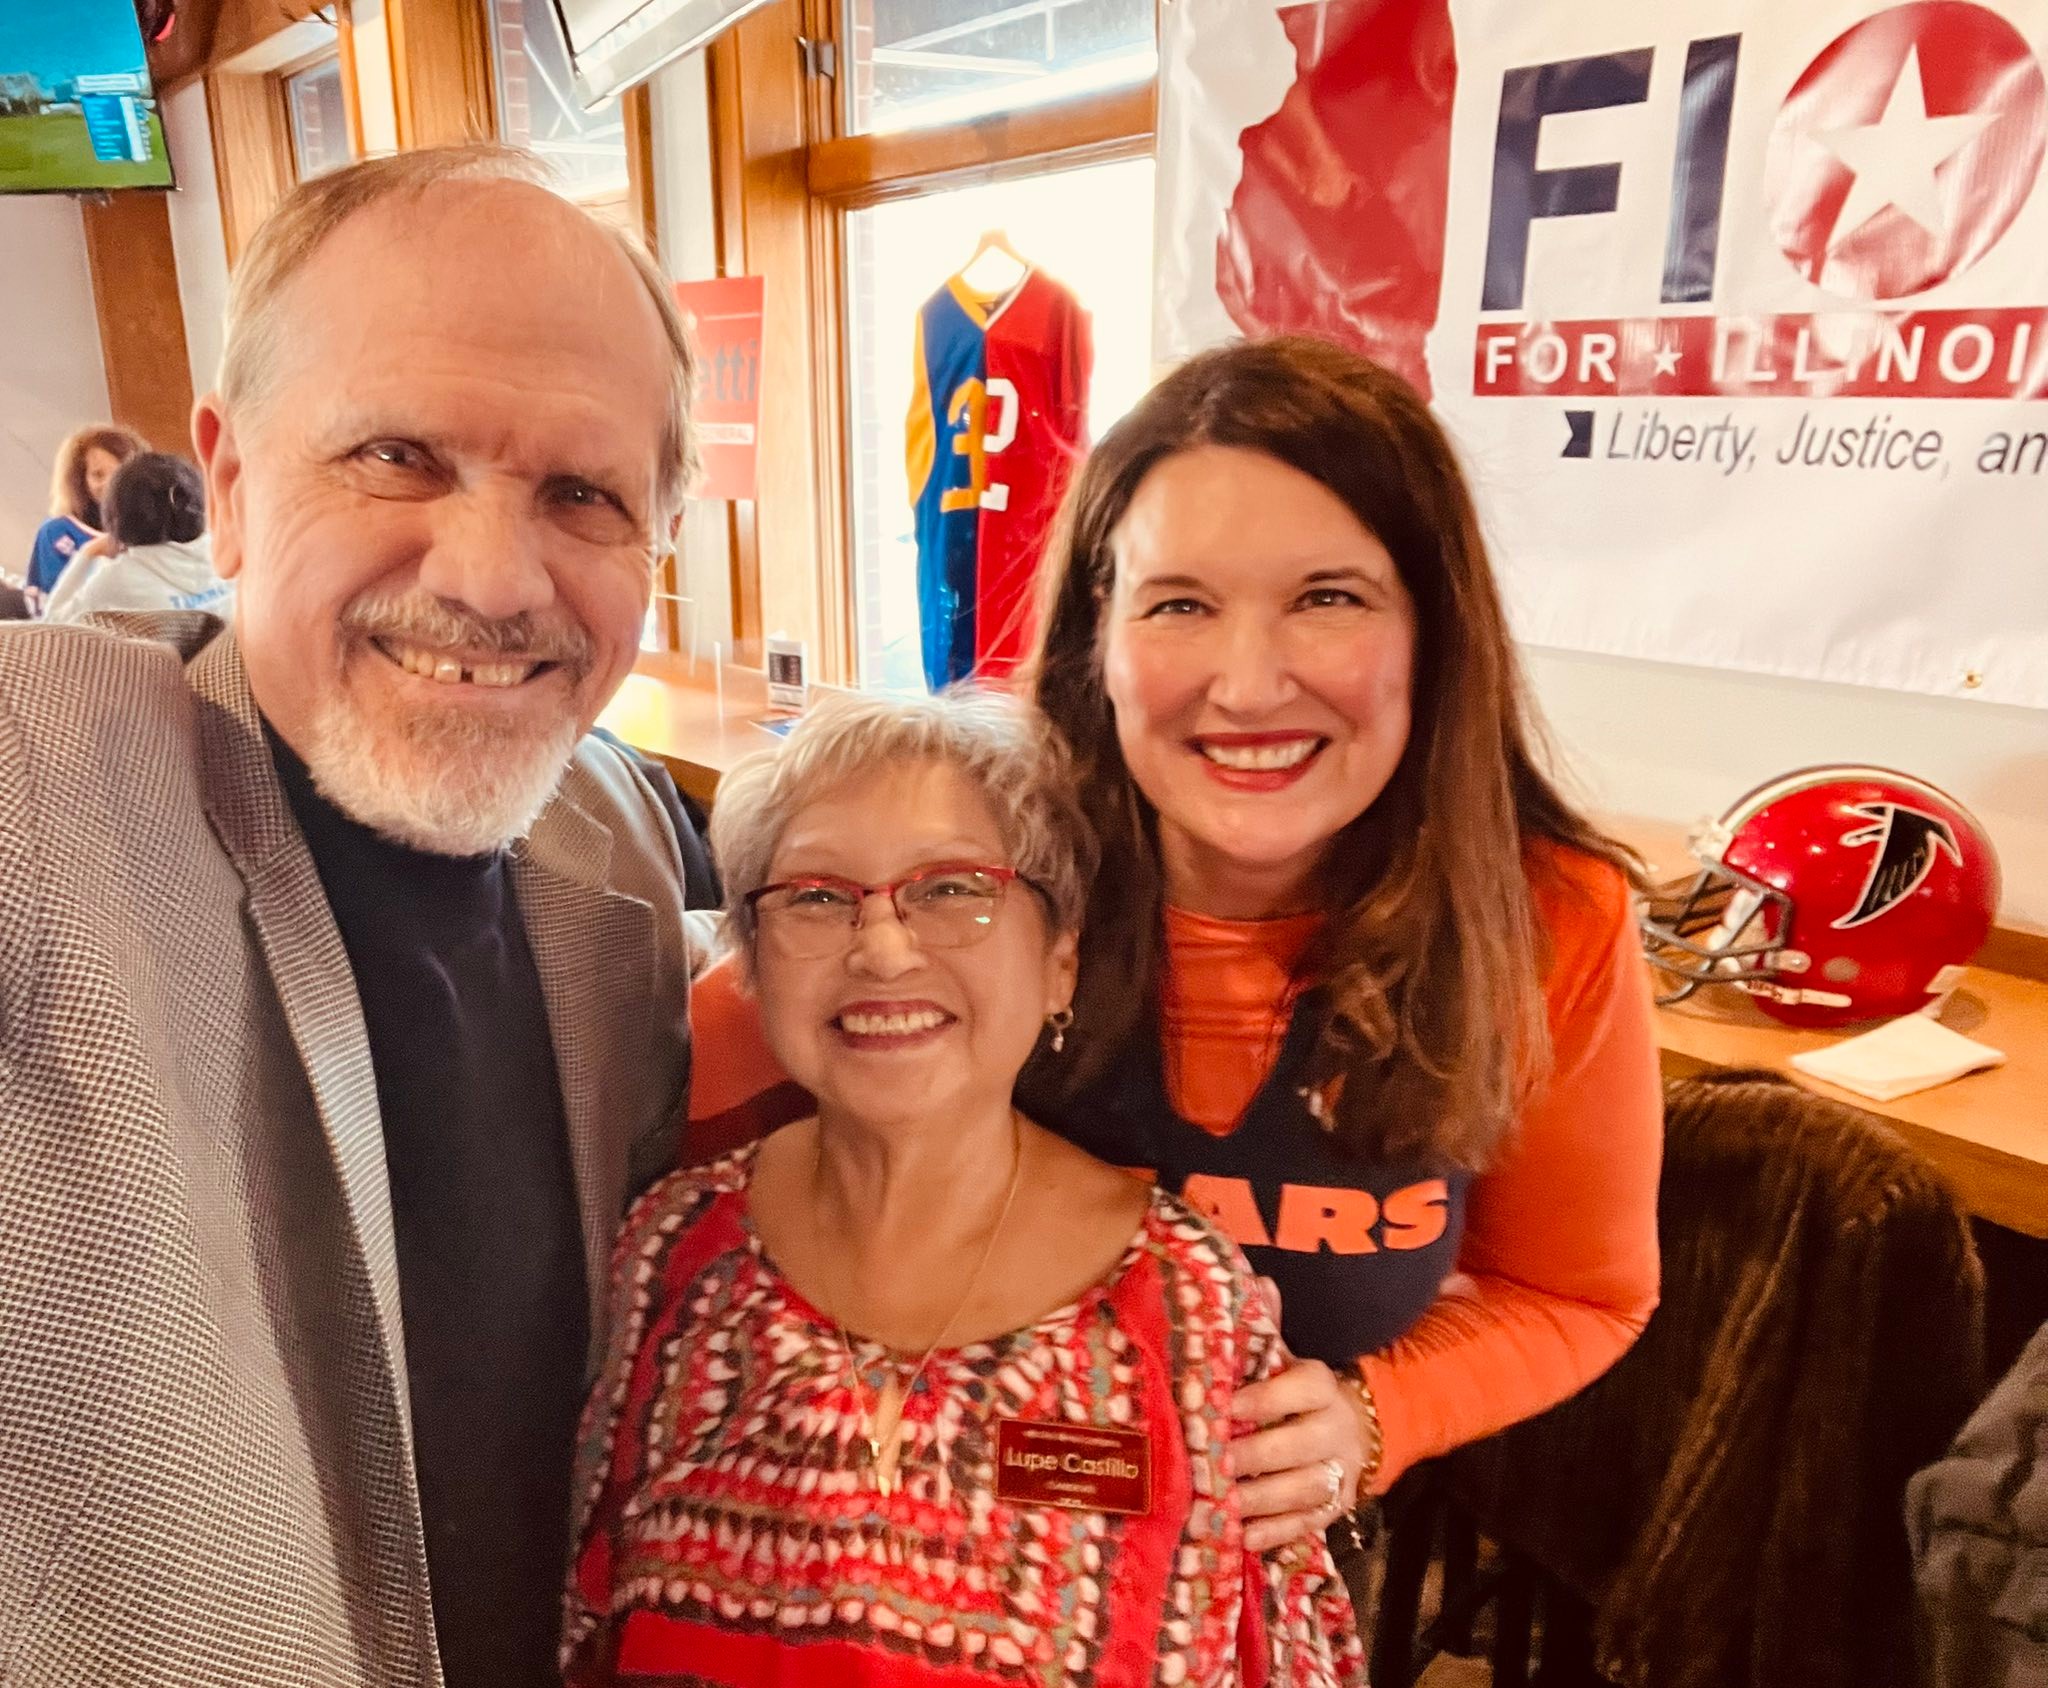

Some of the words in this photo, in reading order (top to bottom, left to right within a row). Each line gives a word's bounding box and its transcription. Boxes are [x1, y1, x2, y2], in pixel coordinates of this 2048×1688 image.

[1485, 333, 1617, 384] FOR
[1606, 410, 1757, 476] Liberty,
[1777, 412, 1951, 481] Justice,
[1977, 431, 2048, 476] an
[1129, 1166, 1448, 1255] ARS
[1004, 1447, 1058, 1472] Lupe
[1061, 1453, 1139, 1479] Castillo
